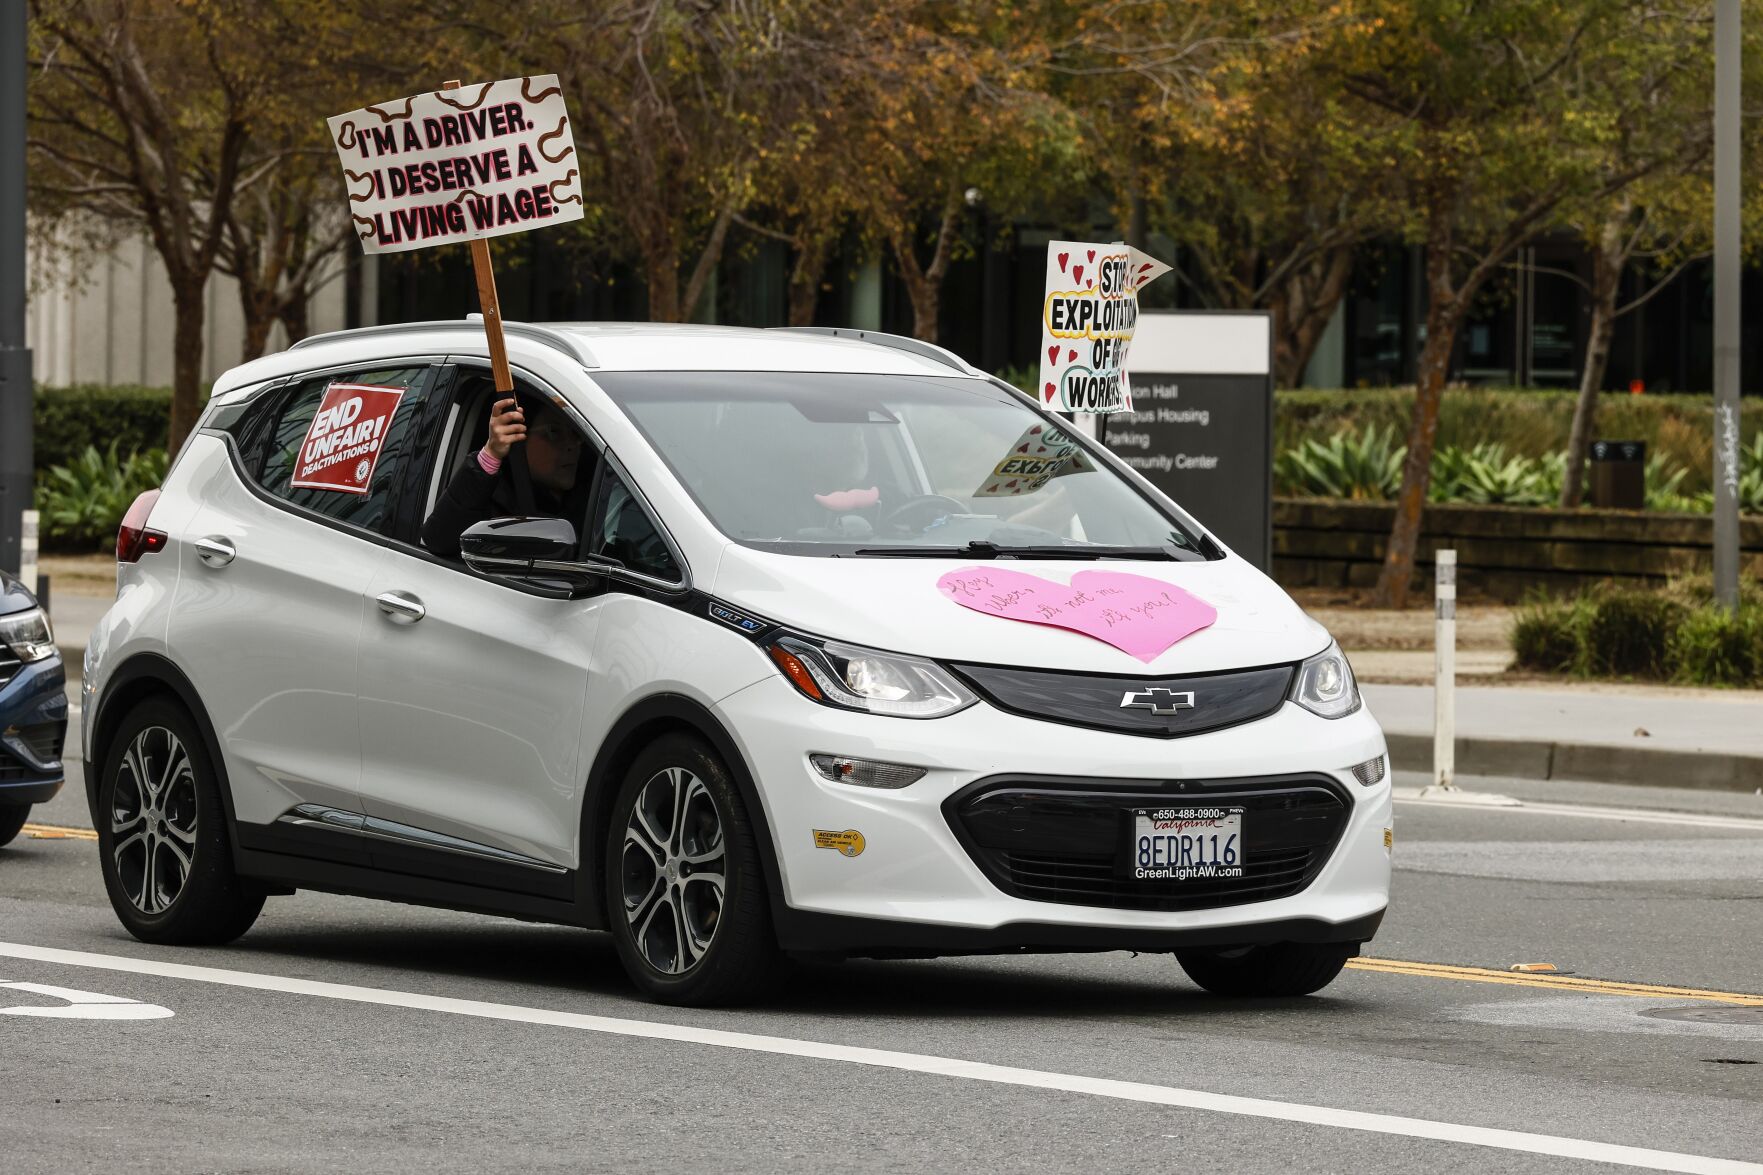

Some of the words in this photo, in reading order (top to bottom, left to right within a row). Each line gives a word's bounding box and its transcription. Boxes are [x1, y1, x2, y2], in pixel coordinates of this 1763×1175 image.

[355, 124, 398, 159] I'M
[403, 121, 423, 152] A
[423, 101, 534, 149] DRIVER.
[373, 169, 386, 200] I
[388, 147, 512, 199] DESERVE
[518, 143, 538, 177] A
[374, 202, 467, 246] LIVING
[466, 183, 560, 230] WAGE.
[1093, 338, 1111, 369] OF
[1152, 384, 1178, 399] Hall
[310, 397, 363, 440] END
[1157, 408, 1209, 426] Housing
[304, 415, 386, 464] UNFAIR!
[1104, 430, 1150, 449] Parking
[301, 442, 371, 478] DEACTIVATIONS
[1174, 453, 1218, 469] Center
[1064, 591, 1095, 608] not
[741, 620, 759, 629] EV
[1158, 809, 1220, 819] 650-488-0900
[1152, 819, 1223, 834] California
[1138, 834, 1237, 867] 8EDR116
[1135, 866, 1242, 880] GreenLightAW.com
